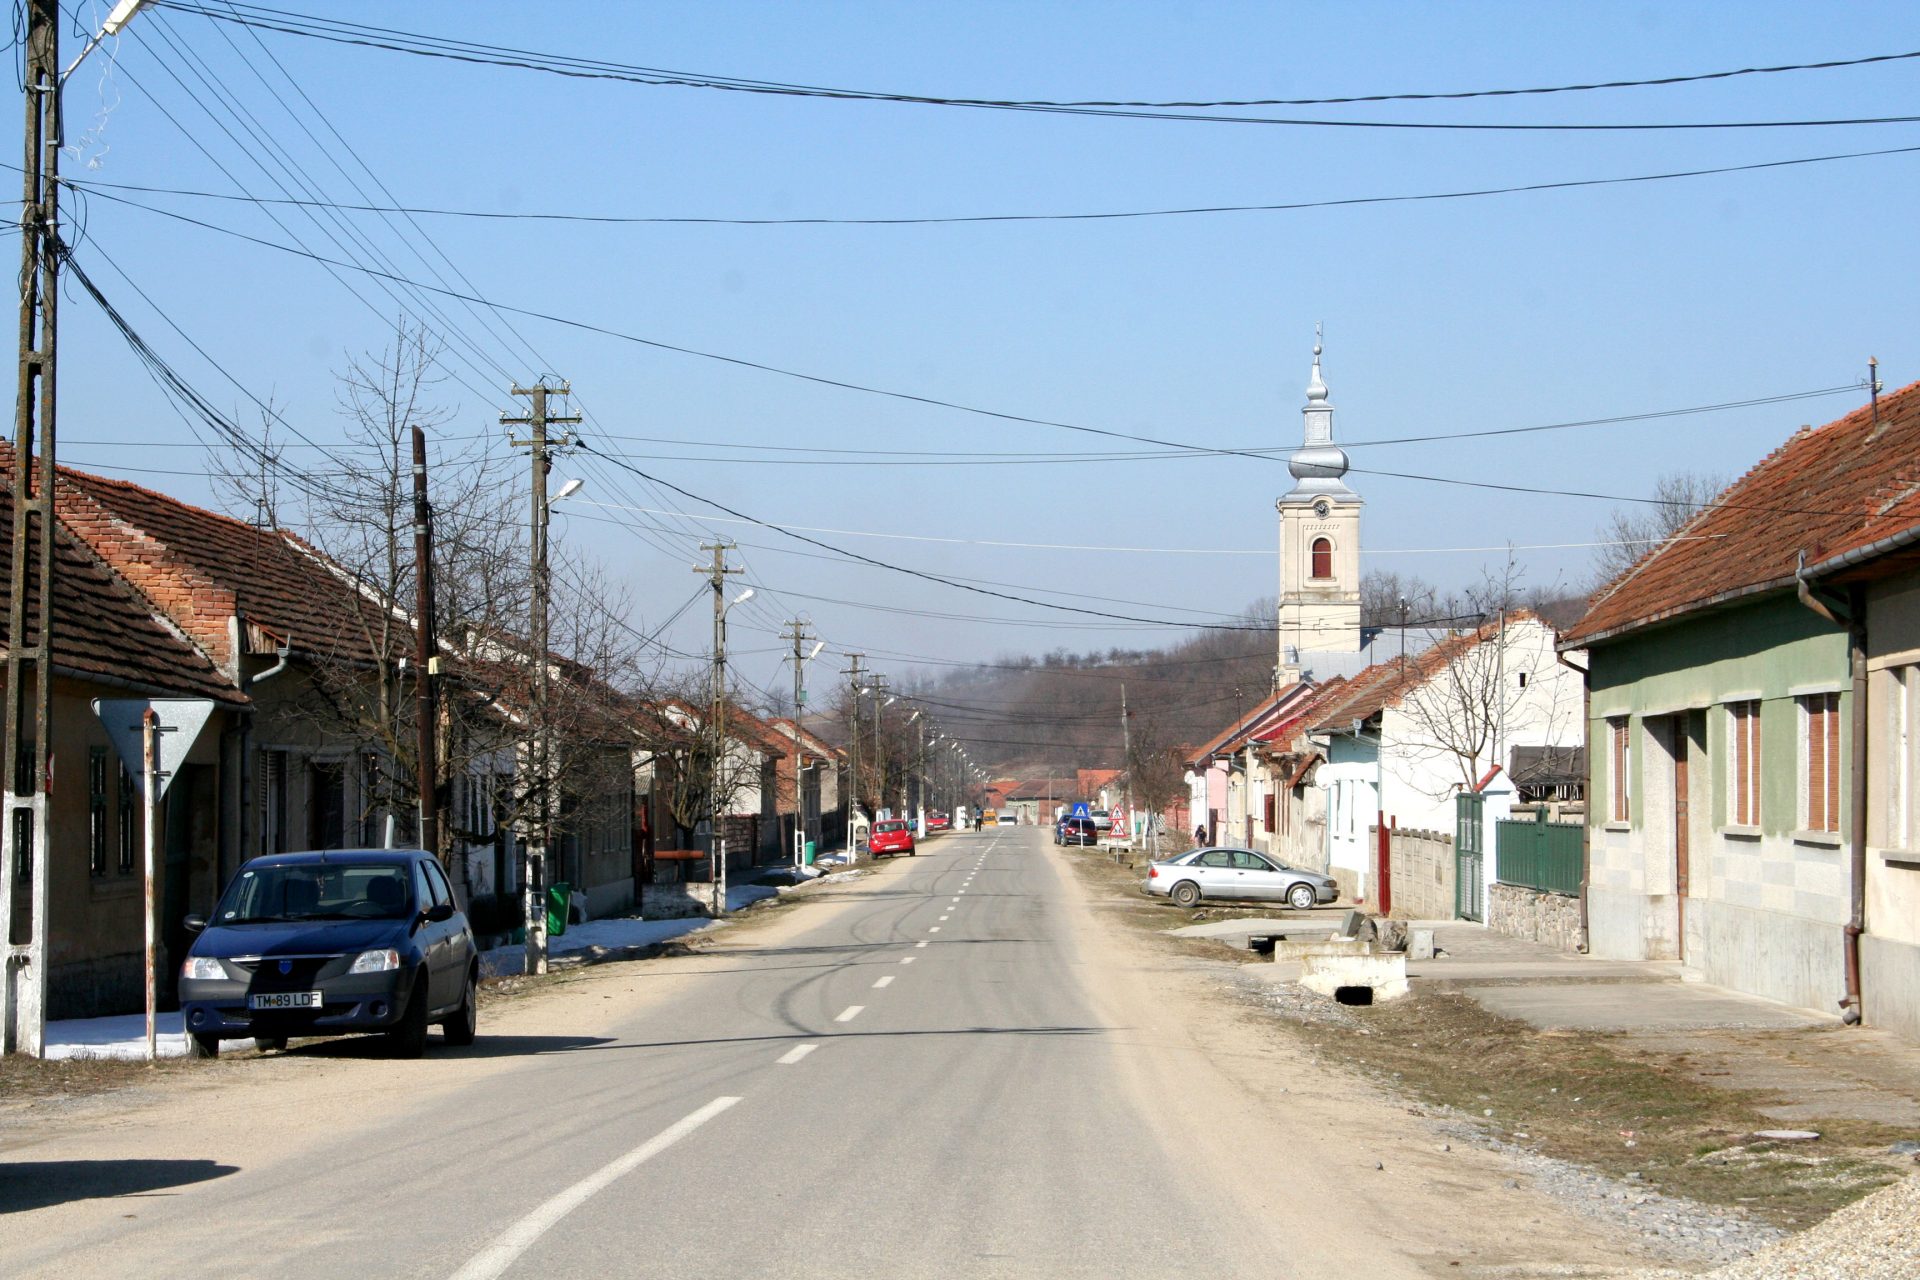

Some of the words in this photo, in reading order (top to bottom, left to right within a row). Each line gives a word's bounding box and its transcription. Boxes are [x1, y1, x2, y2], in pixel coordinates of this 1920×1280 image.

[256, 995, 271, 1007] TM
[276, 994, 291, 1006] 89
[294, 993, 319, 1006] LDF
